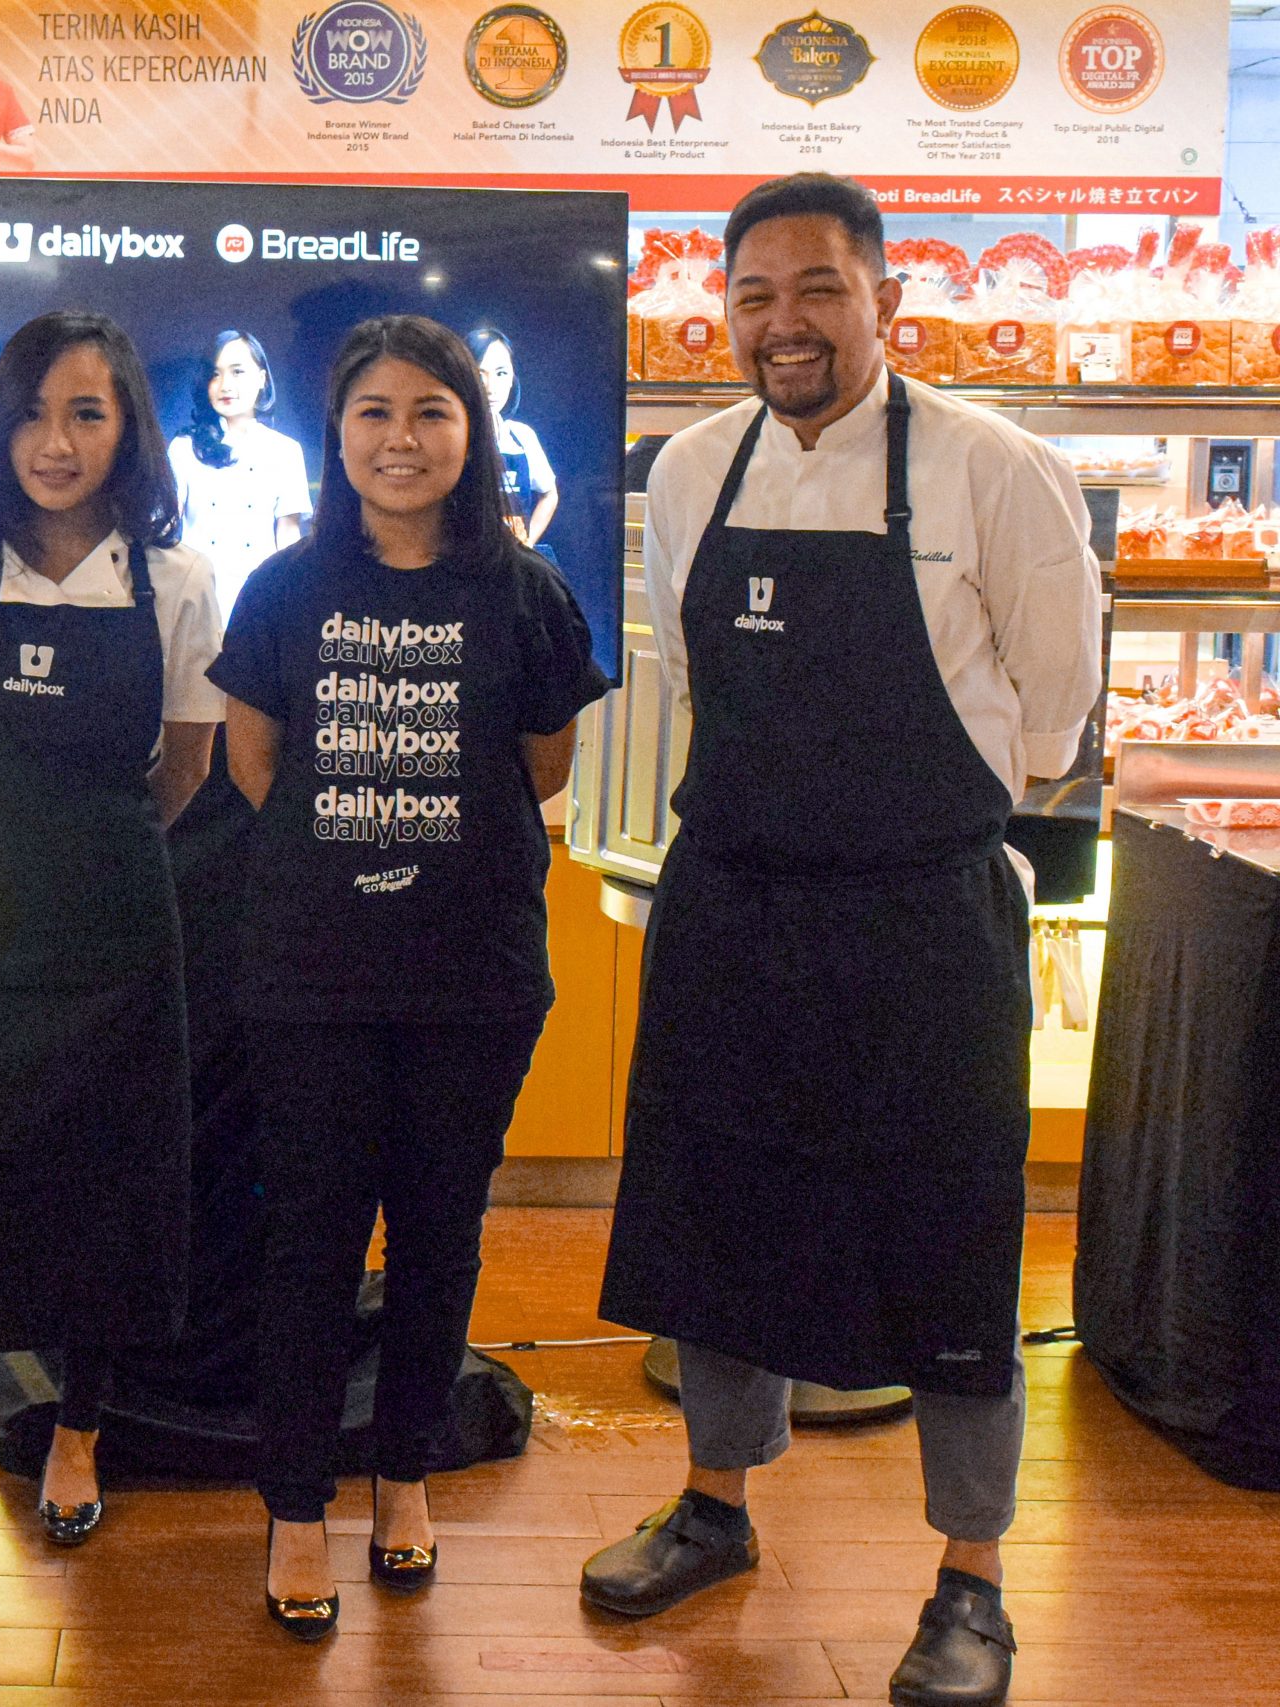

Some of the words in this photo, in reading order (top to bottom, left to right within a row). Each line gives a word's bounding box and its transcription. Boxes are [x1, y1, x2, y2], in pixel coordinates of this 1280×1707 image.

[38, 13, 125, 40] TERIMA
[133, 13, 201, 40] KASIH
[336, 18, 383, 27] INDONESIA
[957, 21, 989, 32] BEST
[326, 29, 393, 52] WOW
[782, 36, 848, 46] INDONESIA
[958, 36, 987, 46] 2018
[492, 46, 539, 56] PERTAMA
[790, 46, 840, 67] Bakery
[328, 53, 391, 70] BRAND
[480, 57, 491, 67] DI
[494, 57, 552, 67] INDONESIA
[1081, 46, 1142, 70] TOP
[38, 56, 95, 83] ATAS
[103, 56, 267, 83] KEPERCAYAAN
[929, 60, 1005, 71] EXCELLENT
[344, 72, 374, 86] 2015
[937, 75, 994, 88] QUALITY
[1081, 71, 1124, 81] DIGITAL
[1126, 71, 1141, 81] PR
[38, 97, 103, 124] ANDA
[325, 120, 356, 129] Bronze
[359, 120, 391, 129] Winner
[472, 121, 501, 130] Baked
[503, 121, 537, 130] Cheese
[539, 121, 556, 130] Tart
[762, 123, 805, 131] Indonesia
[807, 123, 827, 131] Best
[830, 123, 861, 133] Bakery
[907, 119, 921, 127] The
[924, 119, 946, 127] Most
[949, 119, 980, 127] Trusted
[983, 119, 1023, 129] Company
[1054, 124, 1070, 134] Top
[1072, 124, 1102, 134] Digital
[1105, 124, 1131, 132] Public
[1134, 124, 1164, 134] Digital
[307, 132, 350, 140] Indonesia
[353, 132, 380, 140] WOW
[382, 132, 409, 140] Brand
[453, 133, 476, 141] Halal
[478, 133, 516, 141] Pertama
[519, 133, 528, 141] Di
[531, 133, 574, 141] Indonesia
[779, 134, 802, 142] Cake
[815, 134, 843, 144] Pastry
[921, 130, 928, 138] In
[931, 130, 962, 140] Quality
[965, 130, 999, 138] Product
[1097, 136, 1119, 144] 2018
[346, 143, 369, 152] 2015
[601, 139, 644, 148] Indonesia
[646, 139, 666, 147] Best
[669, 139, 729, 149] Enterpreneur
[918, 141, 959, 149] Customer
[961, 141, 1011, 149] Satisfaction
[634, 151, 667, 160] Quality
[670, 150, 705, 159] Product
[800, 146, 822, 154] 2018
[959, 152, 977, 160] Year
[980, 152, 1001, 160] 2018
[903, 188, 982, 203] BreadLife
[998, 186, 1199, 205] スペシャル焼き立てパン
[38, 224, 185, 264] dailybox
[262, 229, 420, 261] BreadLife
[734, 614, 785, 633] dailybox
[321, 611, 464, 653] dailybox
[319, 639, 462, 673] dailybox
[3, 677, 65, 697] dailybox
[316, 671, 460, 711] dailybox
[316, 700, 460, 734] dailybox
[316, 720, 460, 760] dailybox
[314, 750, 461, 783] dailybox
[315, 786, 461, 825] dailybox
[314, 815, 461, 848] dailybox
[382, 864, 420, 881] SETTLE
[362, 883, 379, 893] GO
